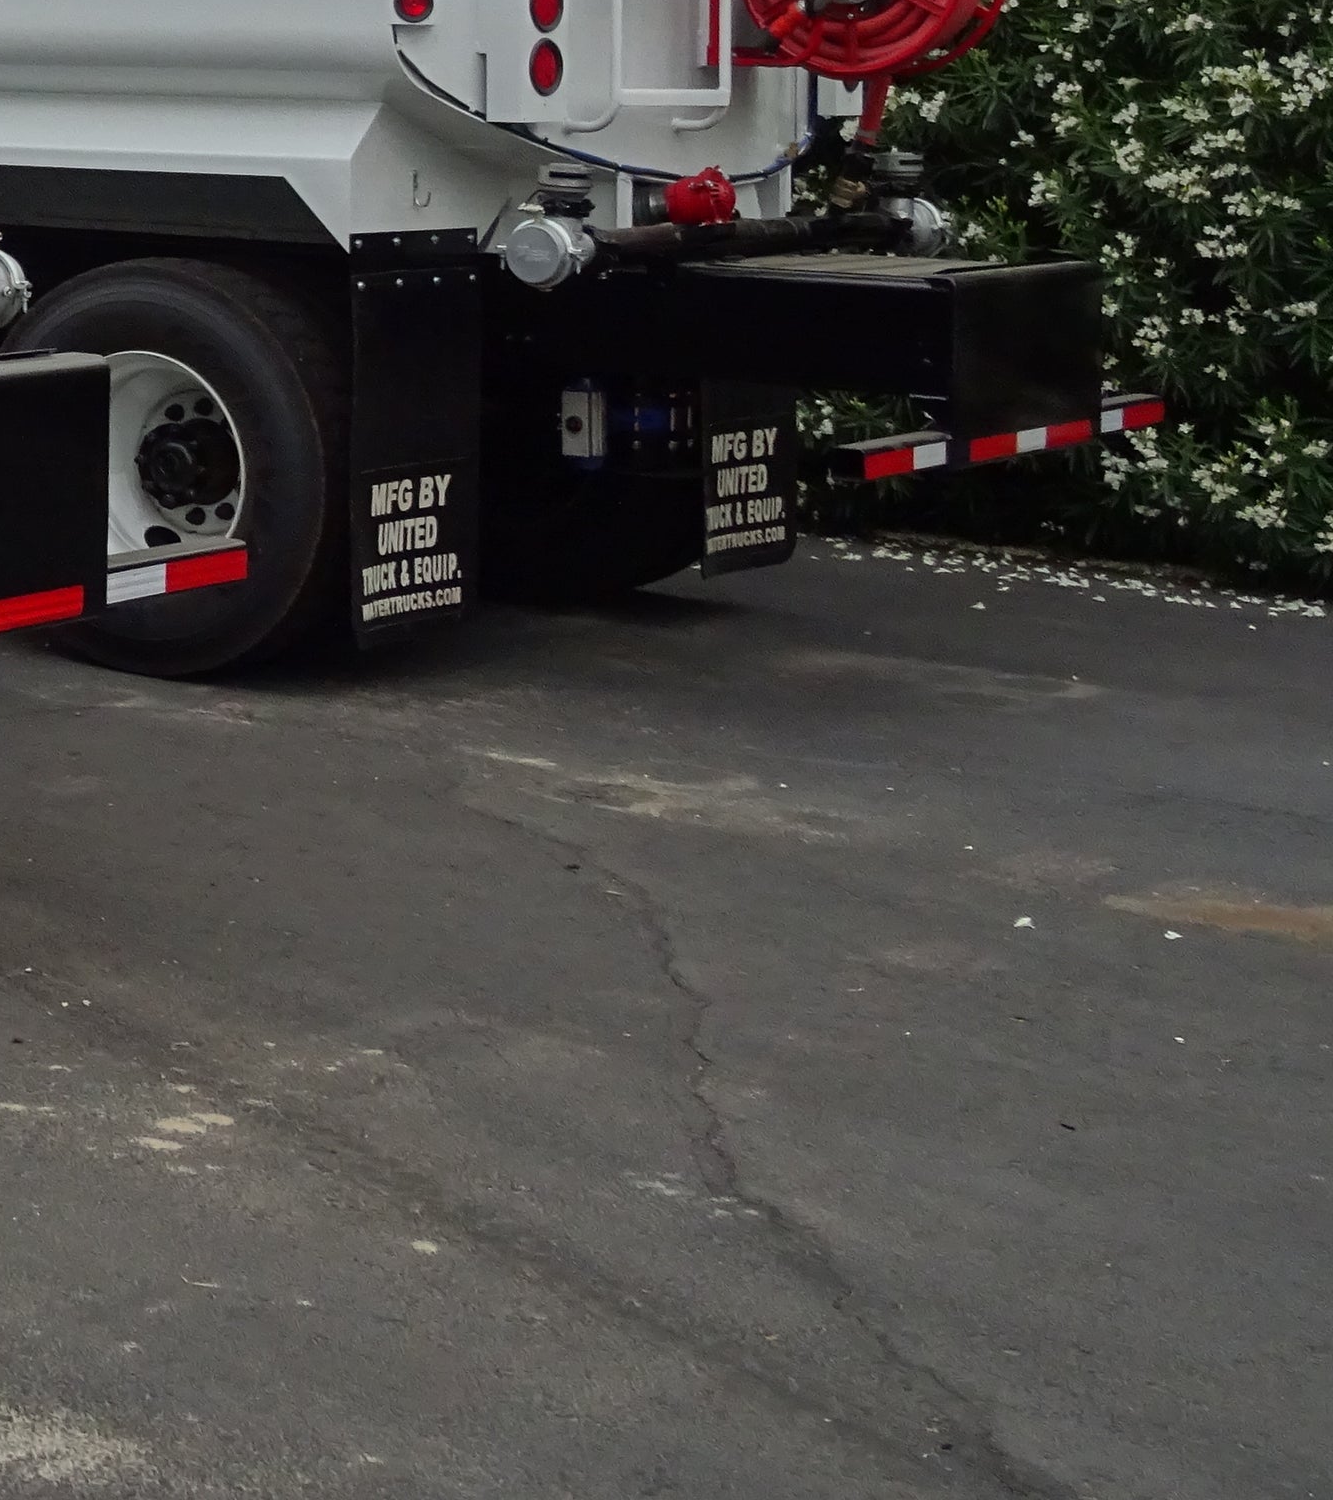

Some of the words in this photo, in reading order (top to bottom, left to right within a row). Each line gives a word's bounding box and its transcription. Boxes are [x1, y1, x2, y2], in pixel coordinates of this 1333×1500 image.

[711, 431, 748, 464] MFG
[752, 427, 778, 458] BY
[371, 479, 413, 517] MFG
[419, 474, 452, 509] BY
[716, 463, 768, 498] UNITED
[735, 501, 744, 525] &
[747, 496, 786, 524] EQUIP.
[378, 516, 438, 556] UNITED
[362, 561, 397, 597] TRUCK
[400, 559, 410, 587] &
[414, 553, 462, 585] EQUIP.
[362, 586, 462, 622] WATERTRUCKS.COM
